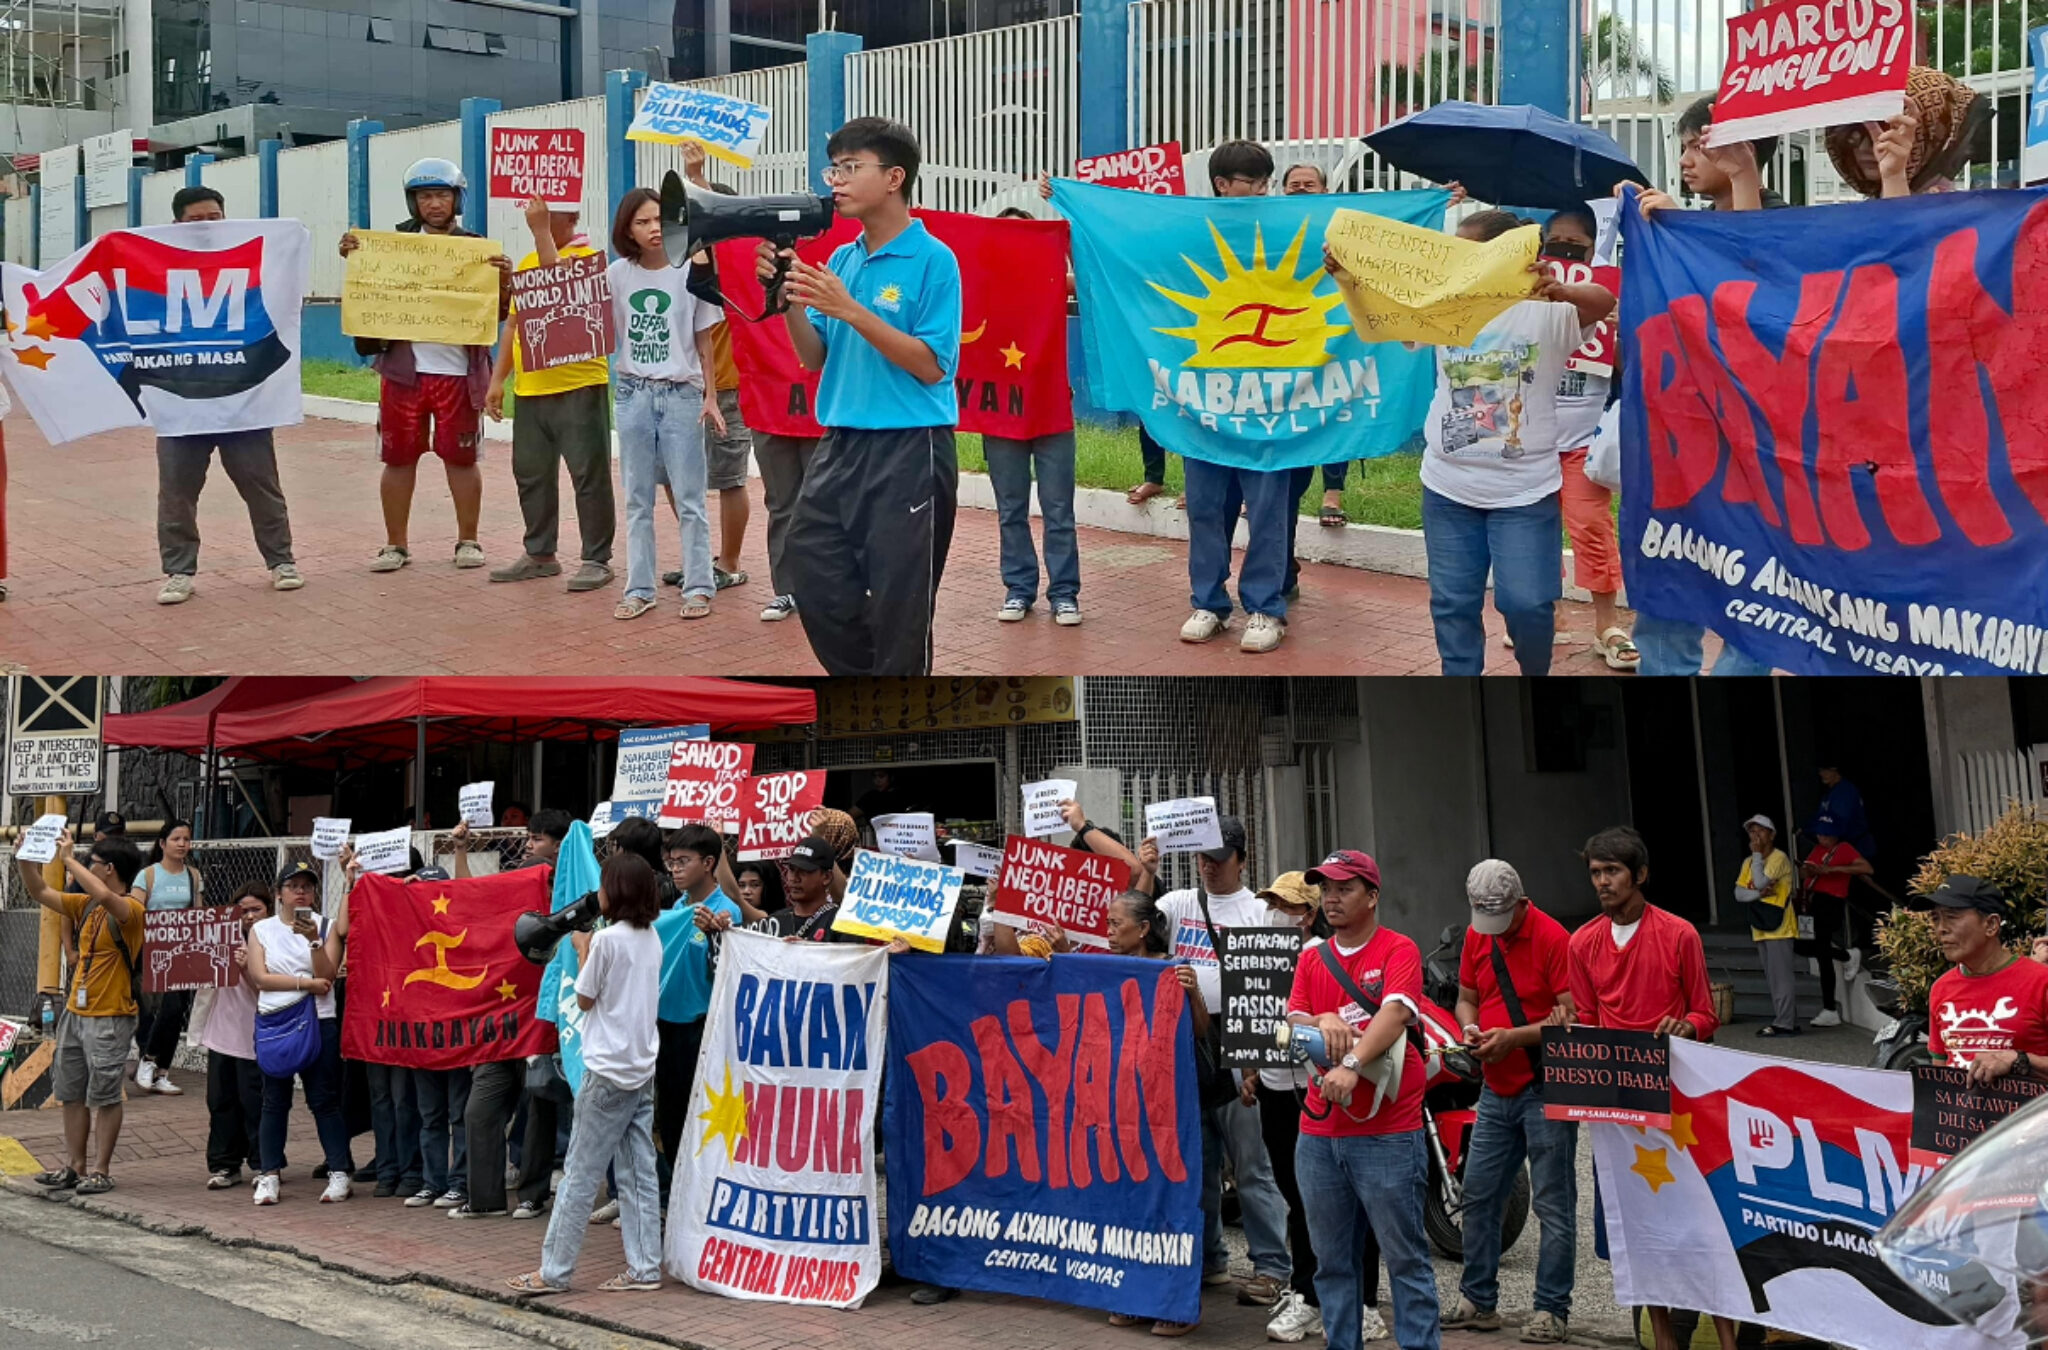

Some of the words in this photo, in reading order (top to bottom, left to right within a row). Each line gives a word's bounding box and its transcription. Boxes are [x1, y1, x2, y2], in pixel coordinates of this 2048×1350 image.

[1736, 0, 1903, 62] MARCOS
[1720, 25, 1905, 104] SINGILON!
[642, 101, 675, 117] DILI
[494, 132, 539, 152] JUNK
[548, 133, 575, 152] ALL
[493, 154, 582, 178] NEOLIBERAL
[1077, 147, 1166, 183] SAHOD
[511, 176, 567, 196] POLICIES
[1339, 216, 1454, 266] INDEPENDENT
[512, 258, 585, 291] WORKERS
[64, 267, 250, 337] PLM
[134, 354, 172, 369] AKAS
[174, 353, 193, 367] NG
[198, 351, 247, 365] MASA
[1147, 356, 1381, 415] KABATAAN
[1635, 198, 2048, 552] BAYAN
[1151, 391, 1381, 436] PARTYLIST
[1640, 517, 1746, 587] BAGONG
[1752, 556, 1900, 642] ALYANSANG
[1908, 602, 2048, 675] MAKABAYA
[1725, 599, 1837, 655] CENTRAL
[1847, 640, 1964, 676] VISAYA
[13, 740, 35, 753] KEEP
[39, 738, 98, 752] INTERSECTION
[15, 753, 43, 766] CLEAR
[46, 751, 67, 765] AND
[69, 750, 96, 763] OPEN
[671, 741, 742, 769] SAHOD
[18, 766, 29, 778] AT
[35, 765, 54, 778] ALL
[60, 763, 91, 777] TIMES
[619, 762, 656, 776] SAHOD
[656, 760, 668, 772] AT
[630, 773, 657, 785] PARA
[664, 779, 737, 807] PRESYO
[755, 772, 807, 808] STOP
[705, 806, 740, 819] IBABA
[763, 802, 790, 821] THE
[742, 810, 814, 846] ATTACKS
[1008, 841, 1067, 870] JUNK
[1078, 857, 1114, 882] ALL
[848, 875, 880, 901] DILI
[145, 908, 216, 926] WORKERS
[1023, 892, 1100, 928] POLICIES
[196, 918, 243, 946] UNITE!
[1177, 926, 1212, 948] BAYA
[1227, 933, 1300, 951] BATAKANG
[1244, 976, 1271, 991] DILI
[1228, 995, 1287, 1018] PASISM
[374, 1011, 519, 1048] ANAKBAYAN
[734, 972, 877, 1071] BAYAN
[1226, 1018, 1244, 1034] SA
[1546, 1041, 1611, 1060] SAHOD
[1614, 1045, 1666, 1066] ITAAS!
[905, 965, 1188, 1197] BAYAN
[1543, 1066, 1613, 1086] PRESYO
[1617, 1070, 1670, 1091] IBABA!
[1935, 1089, 1952, 1105] SA
[733, 1081, 864, 1174] MUNA
[1938, 1111, 1966, 1129] DILI
[1935, 1132, 1956, 1149] UG
[710, 1180, 863, 1241] PARTYLIST
[908, 1204, 1000, 1240] BAGONG
[1004, 1211, 1098, 1255] ALYANSANG
[1102, 1225, 1194, 1267] MAKABAYAN
[1741, 1208, 1819, 1243] PARTIDO
[1823, 1228, 1877, 1258] LAKAS
[697, 1236, 785, 1296] CENTRAL
[781, 1254, 860, 1302] VISAYAS
[984, 1249, 1058, 1274] CENTRAL
[1066, 1258, 1125, 1288] VISAYAS
